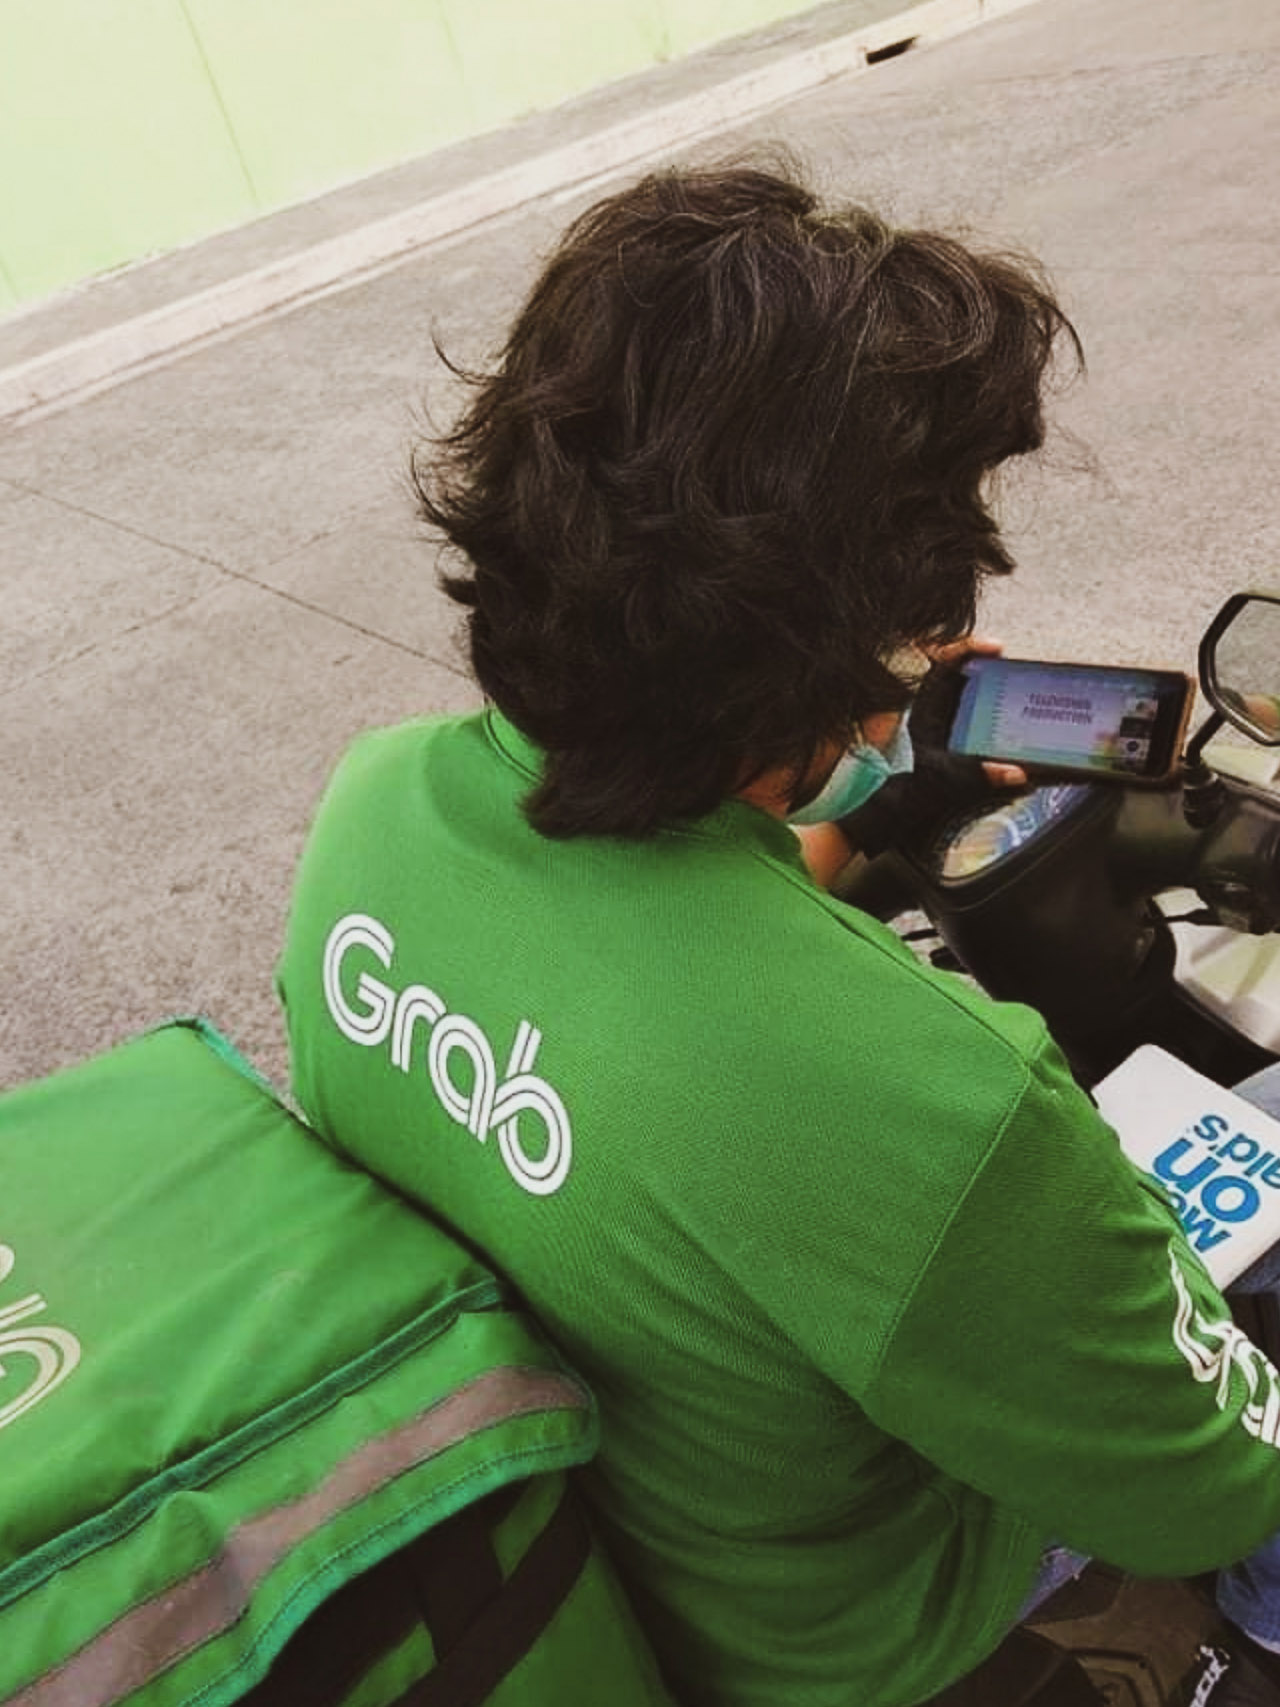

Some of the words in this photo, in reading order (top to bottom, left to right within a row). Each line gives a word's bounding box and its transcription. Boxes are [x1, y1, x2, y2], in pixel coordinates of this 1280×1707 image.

[323, 913, 572, 1196] Grab
[1152, 1137, 1260, 1223] on
[1168, 1240, 1280, 1449] Gra
